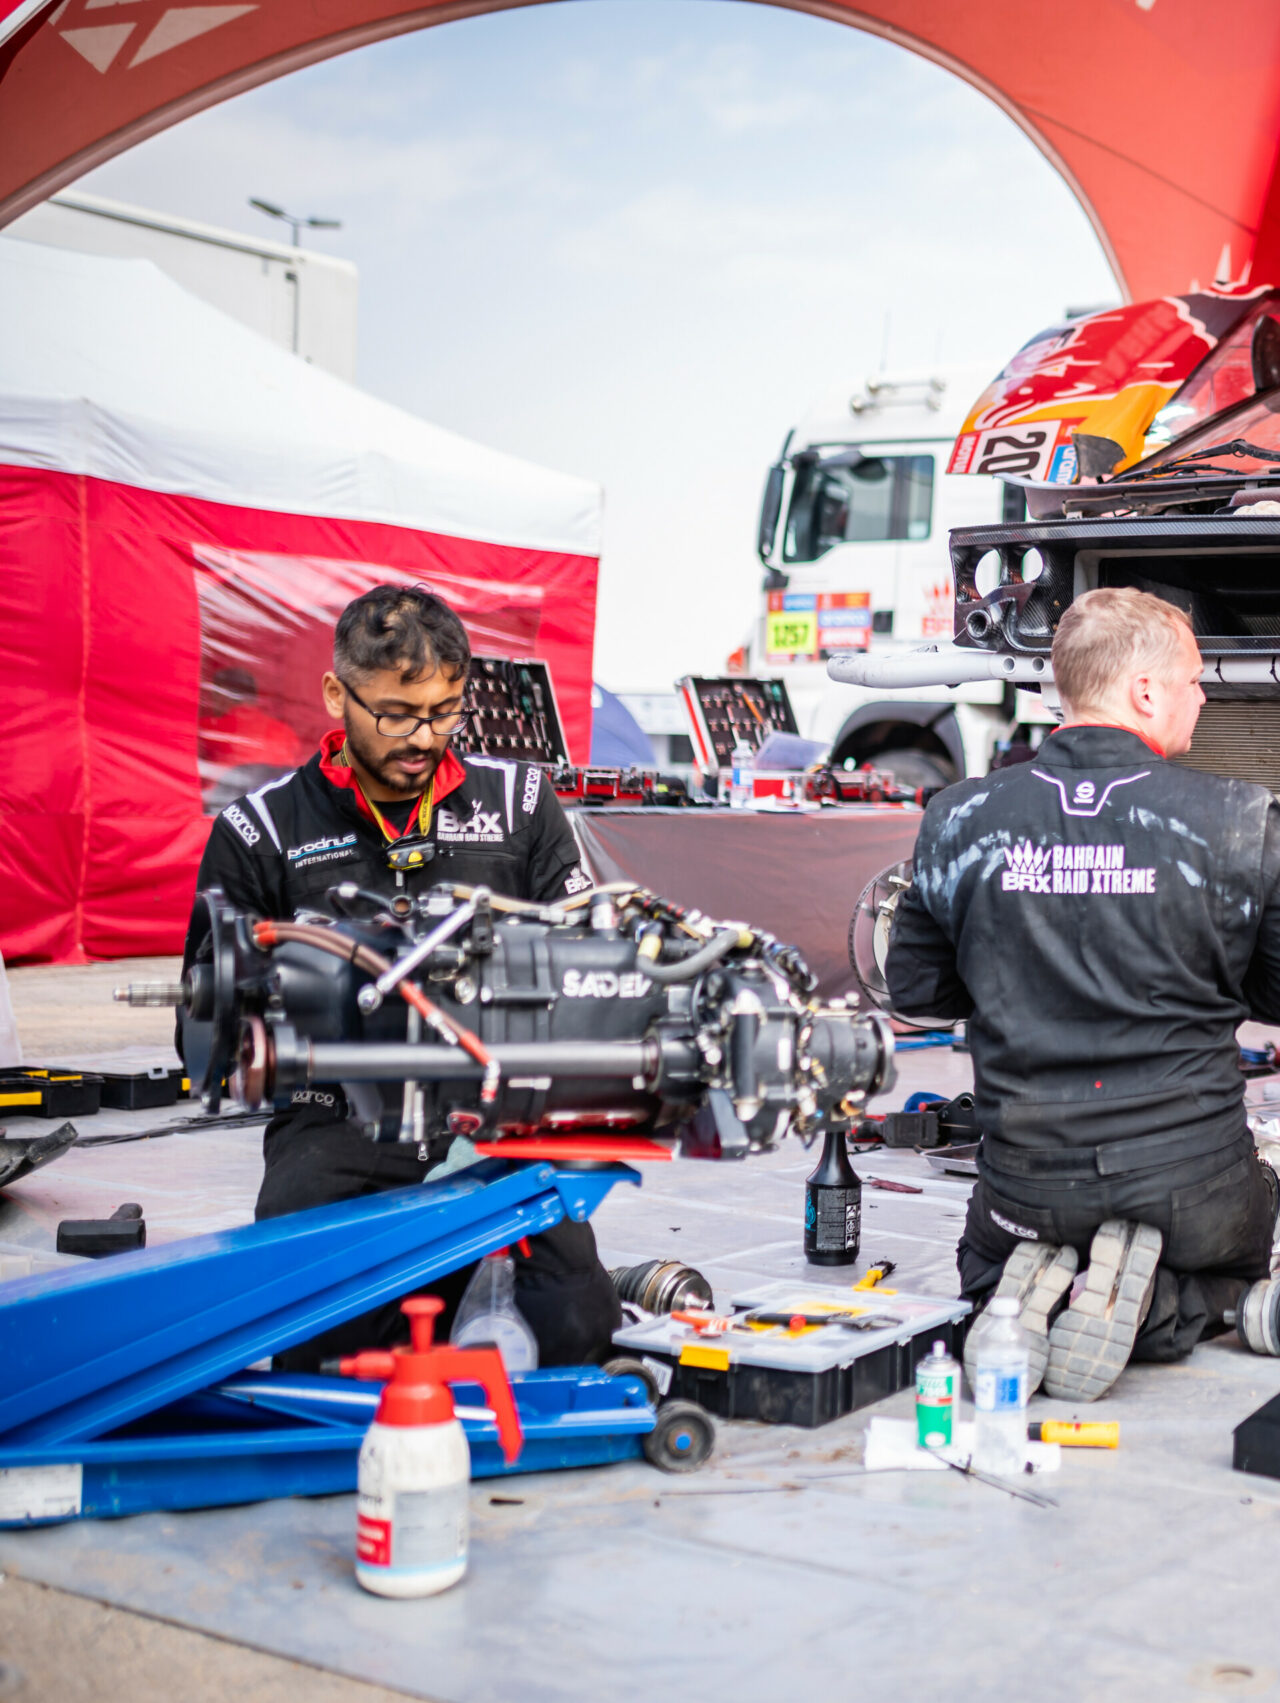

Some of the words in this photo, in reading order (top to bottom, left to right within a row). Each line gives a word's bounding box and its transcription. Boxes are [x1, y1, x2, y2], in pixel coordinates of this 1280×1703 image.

[977, 431, 1047, 480] 20
[222, 804, 261, 846] sparco
[1052, 845, 1125, 870] BAHRAIN
[1053, 869, 1089, 894] RAID
[1091, 868, 1156, 894] XTREME
[562, 968, 653, 998] SADEV
